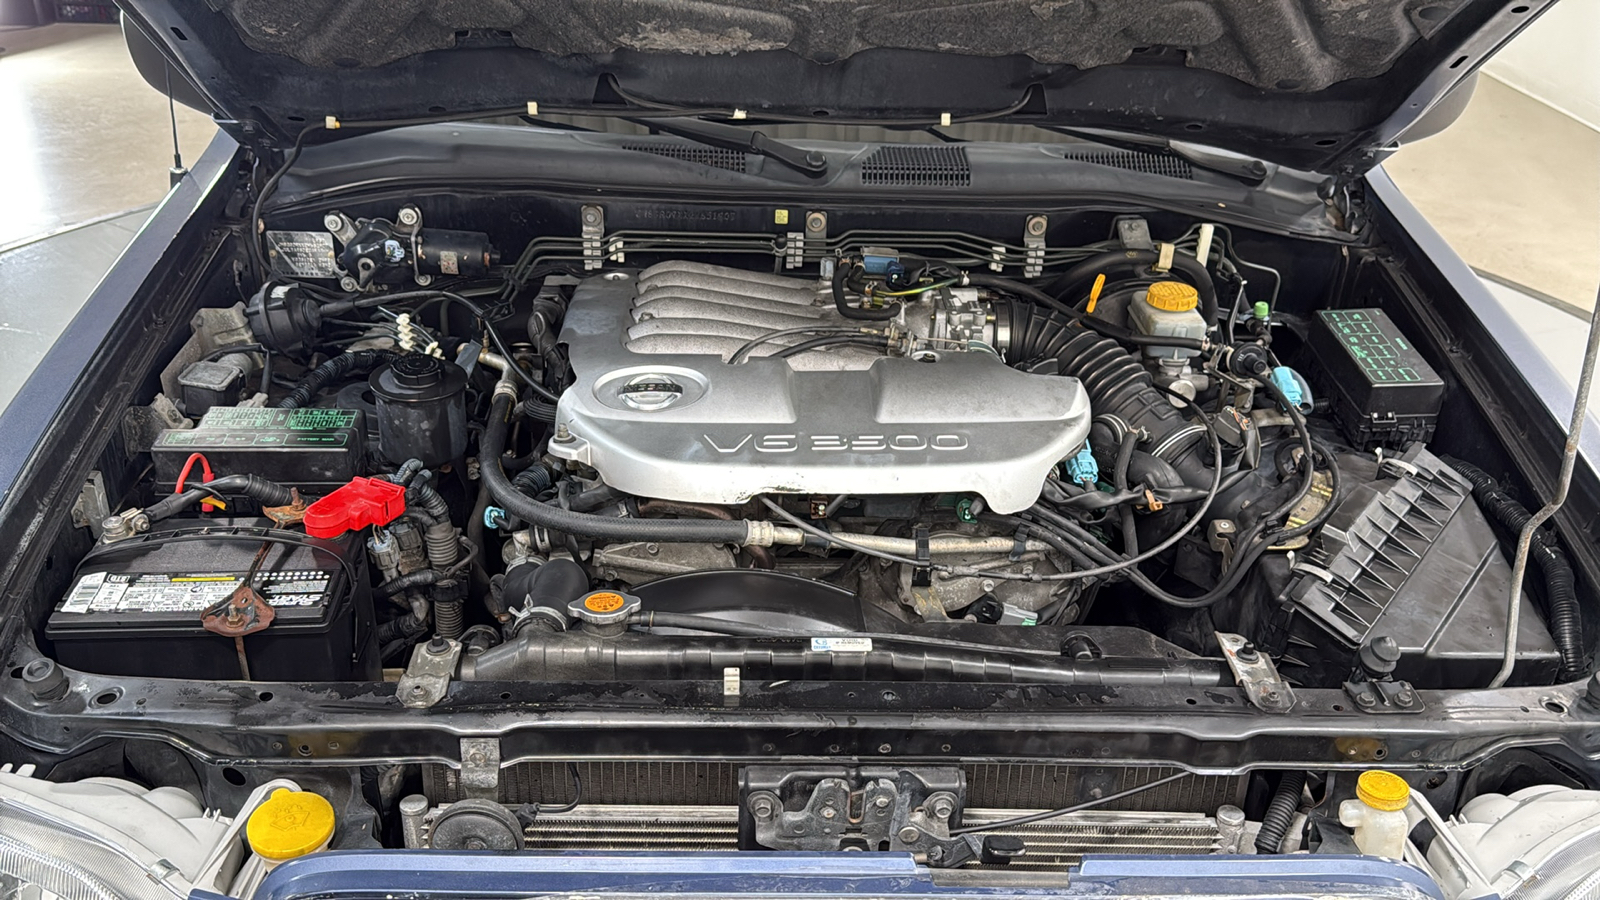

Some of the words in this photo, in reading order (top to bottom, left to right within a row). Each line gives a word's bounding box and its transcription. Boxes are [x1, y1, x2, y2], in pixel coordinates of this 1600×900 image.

[624, 383, 676, 391] NISSAN
[703, 433, 798, 453] V6
[810, 433, 969, 451] 3500
[271, 594, 323, 602] START
